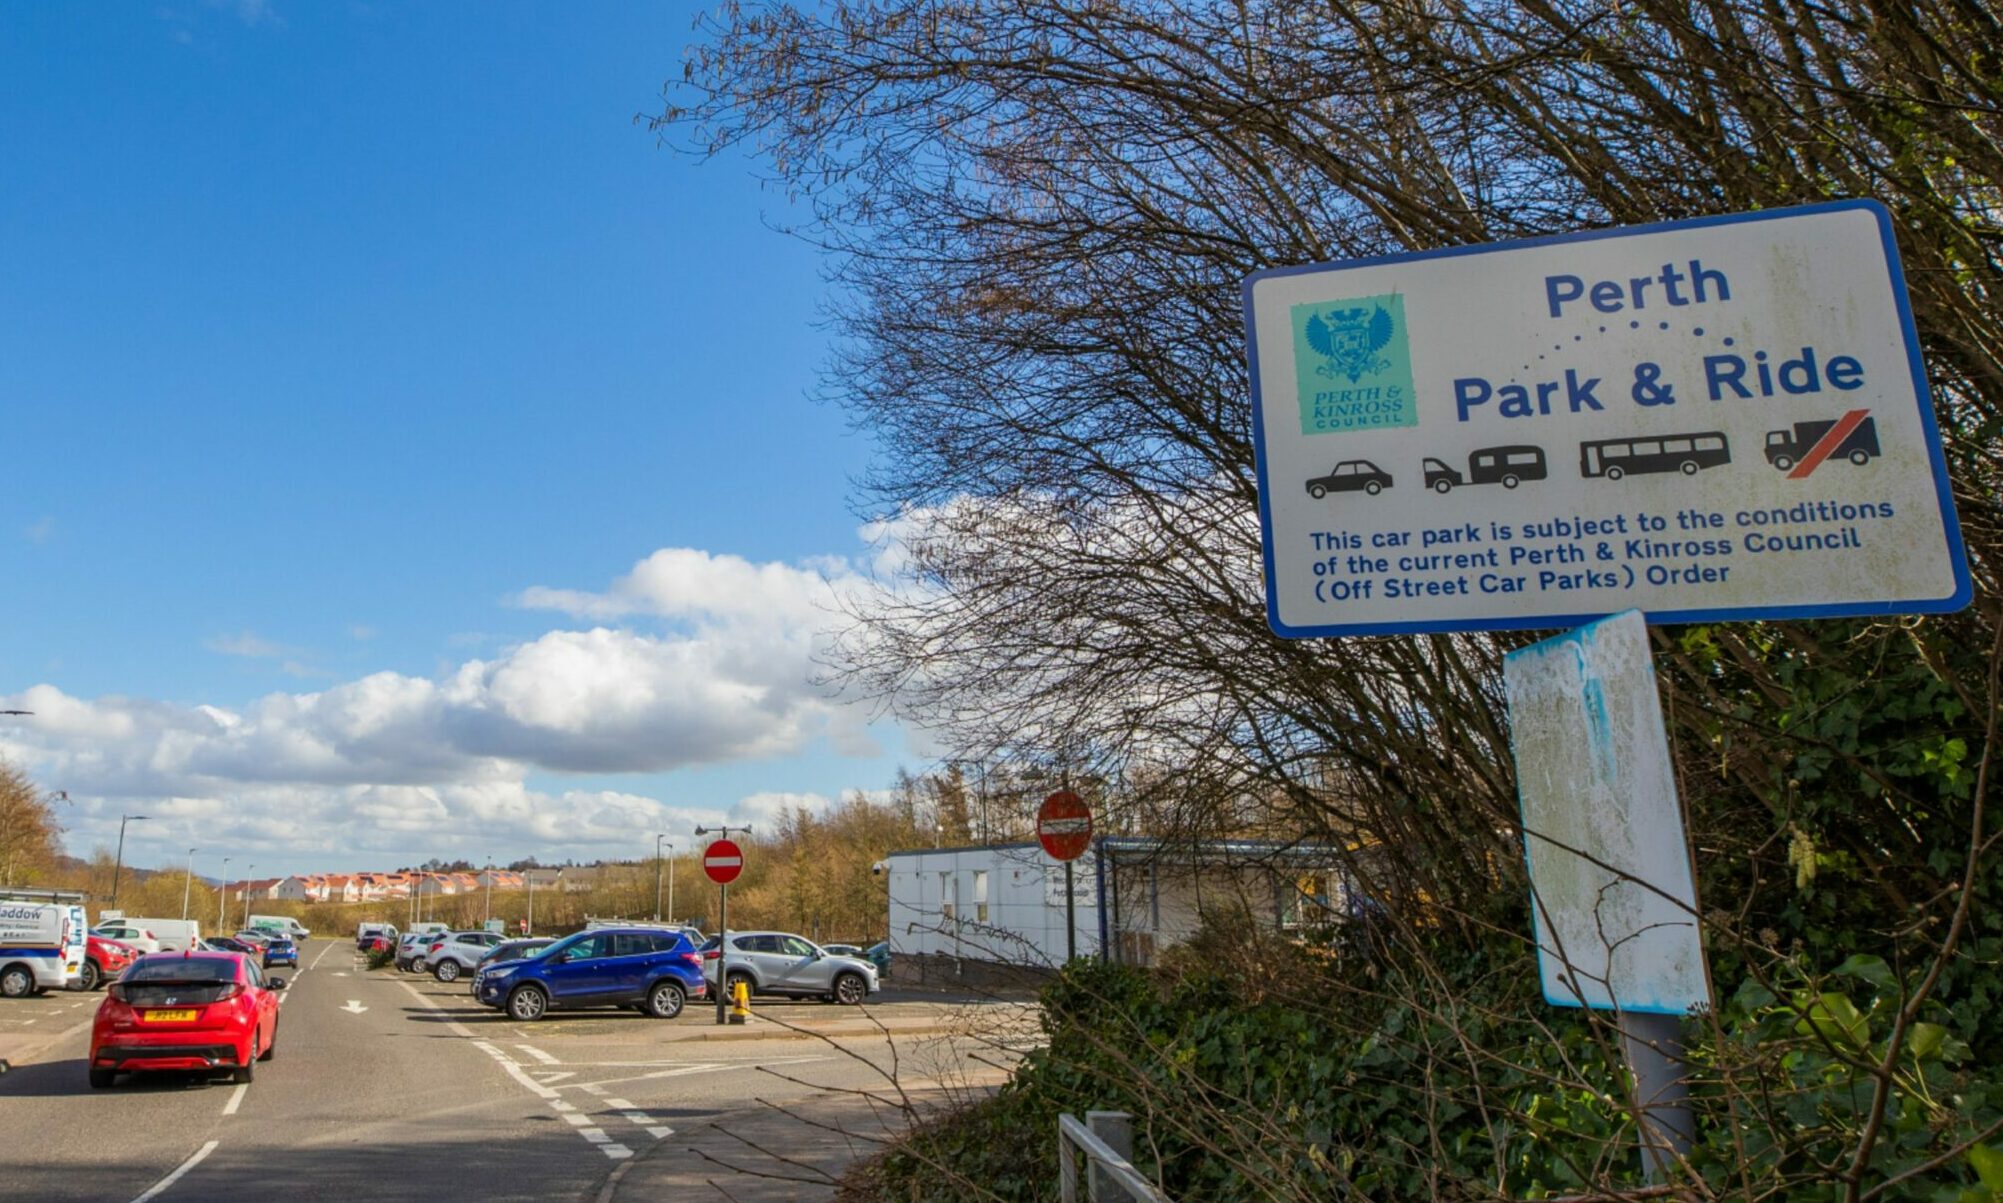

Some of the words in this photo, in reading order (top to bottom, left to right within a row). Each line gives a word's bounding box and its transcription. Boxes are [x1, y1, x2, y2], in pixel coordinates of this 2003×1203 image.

[1544, 259, 1731, 318] Perth
[1314, 387, 1380, 405] PERTH
[1386, 385, 1402, 399] &
[1453, 368, 1606, 422] Park
[1631, 362, 1676, 407] &
[1703, 346, 1865, 401] Ride
[1313, 398, 1403, 418] KINROSS
[1316, 413, 1403, 429] COUNCIL
[1310, 531, 1362, 551] This
[1371, 530, 1411, 548] car
[1422, 523, 1481, 548] park
[1490, 522, 1512, 541] is
[1522, 514, 1628, 540] subject
[1637, 513, 1666, 532] to
[1676, 509, 1725, 530] the
[1735, 500, 1895, 527] conditions
[1312, 556, 1337, 576] of
[1347, 555, 1389, 574] the
[1399, 548, 1499, 572] current
[1510, 543, 1585, 566] Perth
[1596, 541, 1614, 560] &
[1625, 537, 1733, 560] Kinross
[1744, 527, 1862, 553] Council
[1315, 579, 1372, 603] (Off
[1384, 576, 1469, 598] Street
[1479, 573, 1526, 593] Car
[1539, 564, 1635, 590] Parks)
[1646, 563, 1730, 586] Order
[0, 908, 42, 920] addow
